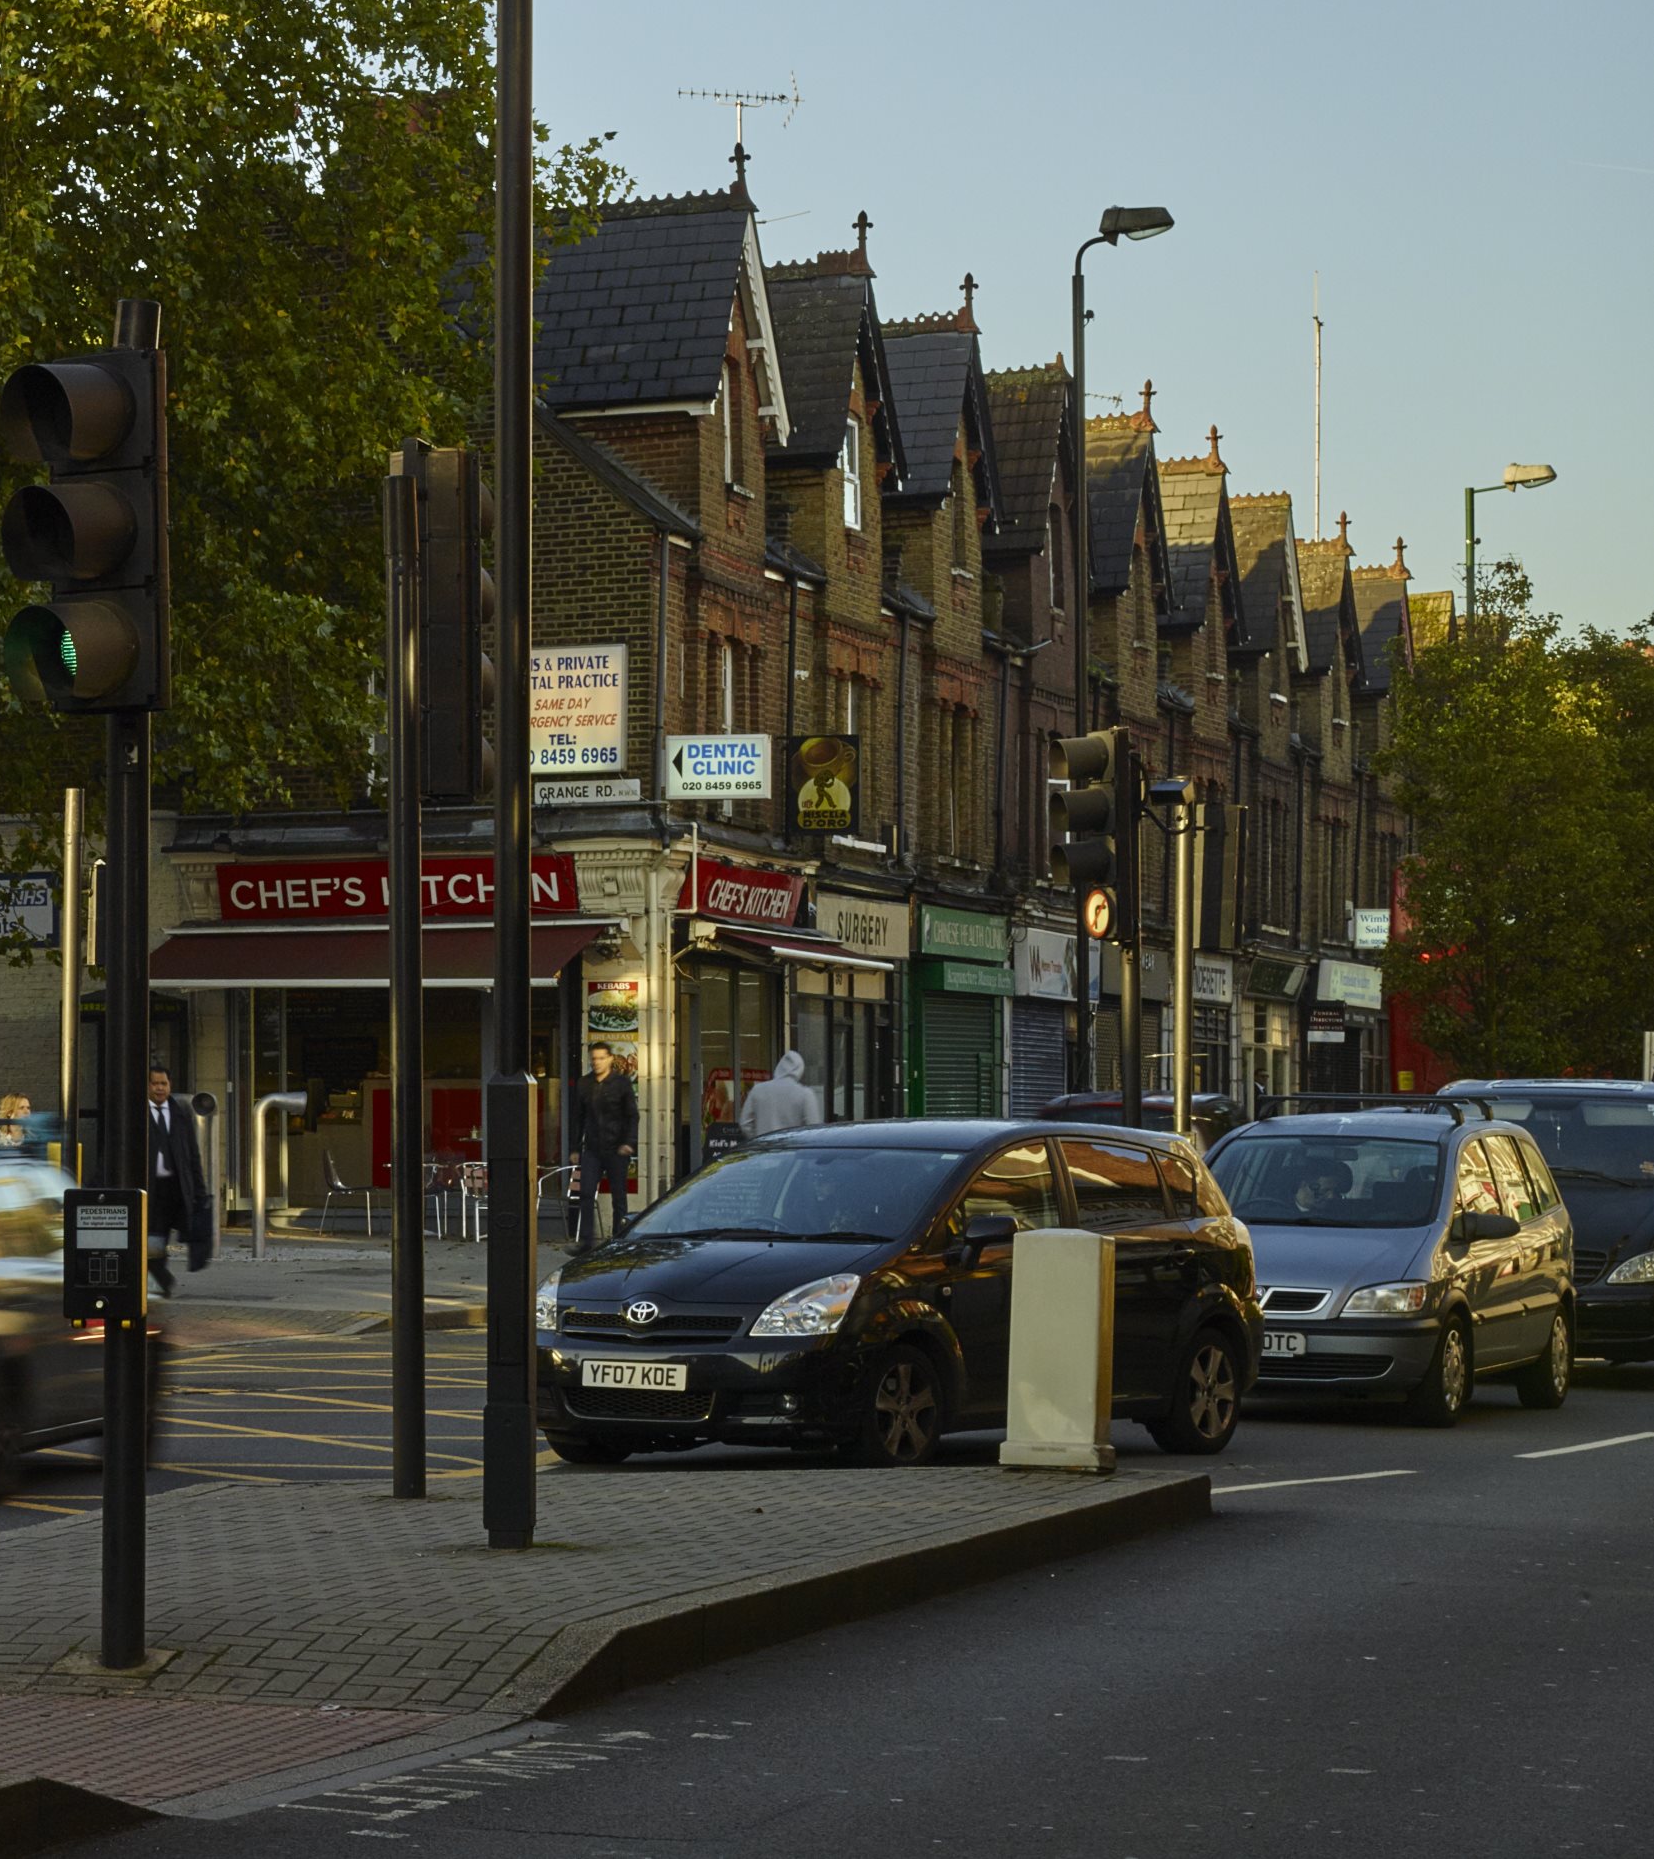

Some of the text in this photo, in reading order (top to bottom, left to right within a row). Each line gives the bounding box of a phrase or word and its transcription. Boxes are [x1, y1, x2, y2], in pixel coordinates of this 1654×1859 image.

[545, 658, 552, 671] &
[558, 655, 609, 671] PRIVATE
[558, 673, 619, 689] PRACTICE
[534, 697, 591, 711] SAME DAY
[575, 713, 617, 727] SERVICE
[549, 734, 576, 745] TEL:
[541, 748, 575, 765] 8459
[581, 747, 617, 763] 6965
[687, 743, 761, 758] DENTAL
[693, 760, 755, 776] CLINIC
[539, 785, 589, 800] GRANGE
[595, 785, 616, 797] RD.
[682, 781, 762, 790] 020 8459 6965
[230, 877, 366, 910] CHEF'S
[708, 878, 792, 919] CHEF'S KITCHEN
[837, 911, 889, 946] SURGERY
[597, 982, 630, 990] KEBABS
[590, 1364, 636, 1385] YF07
